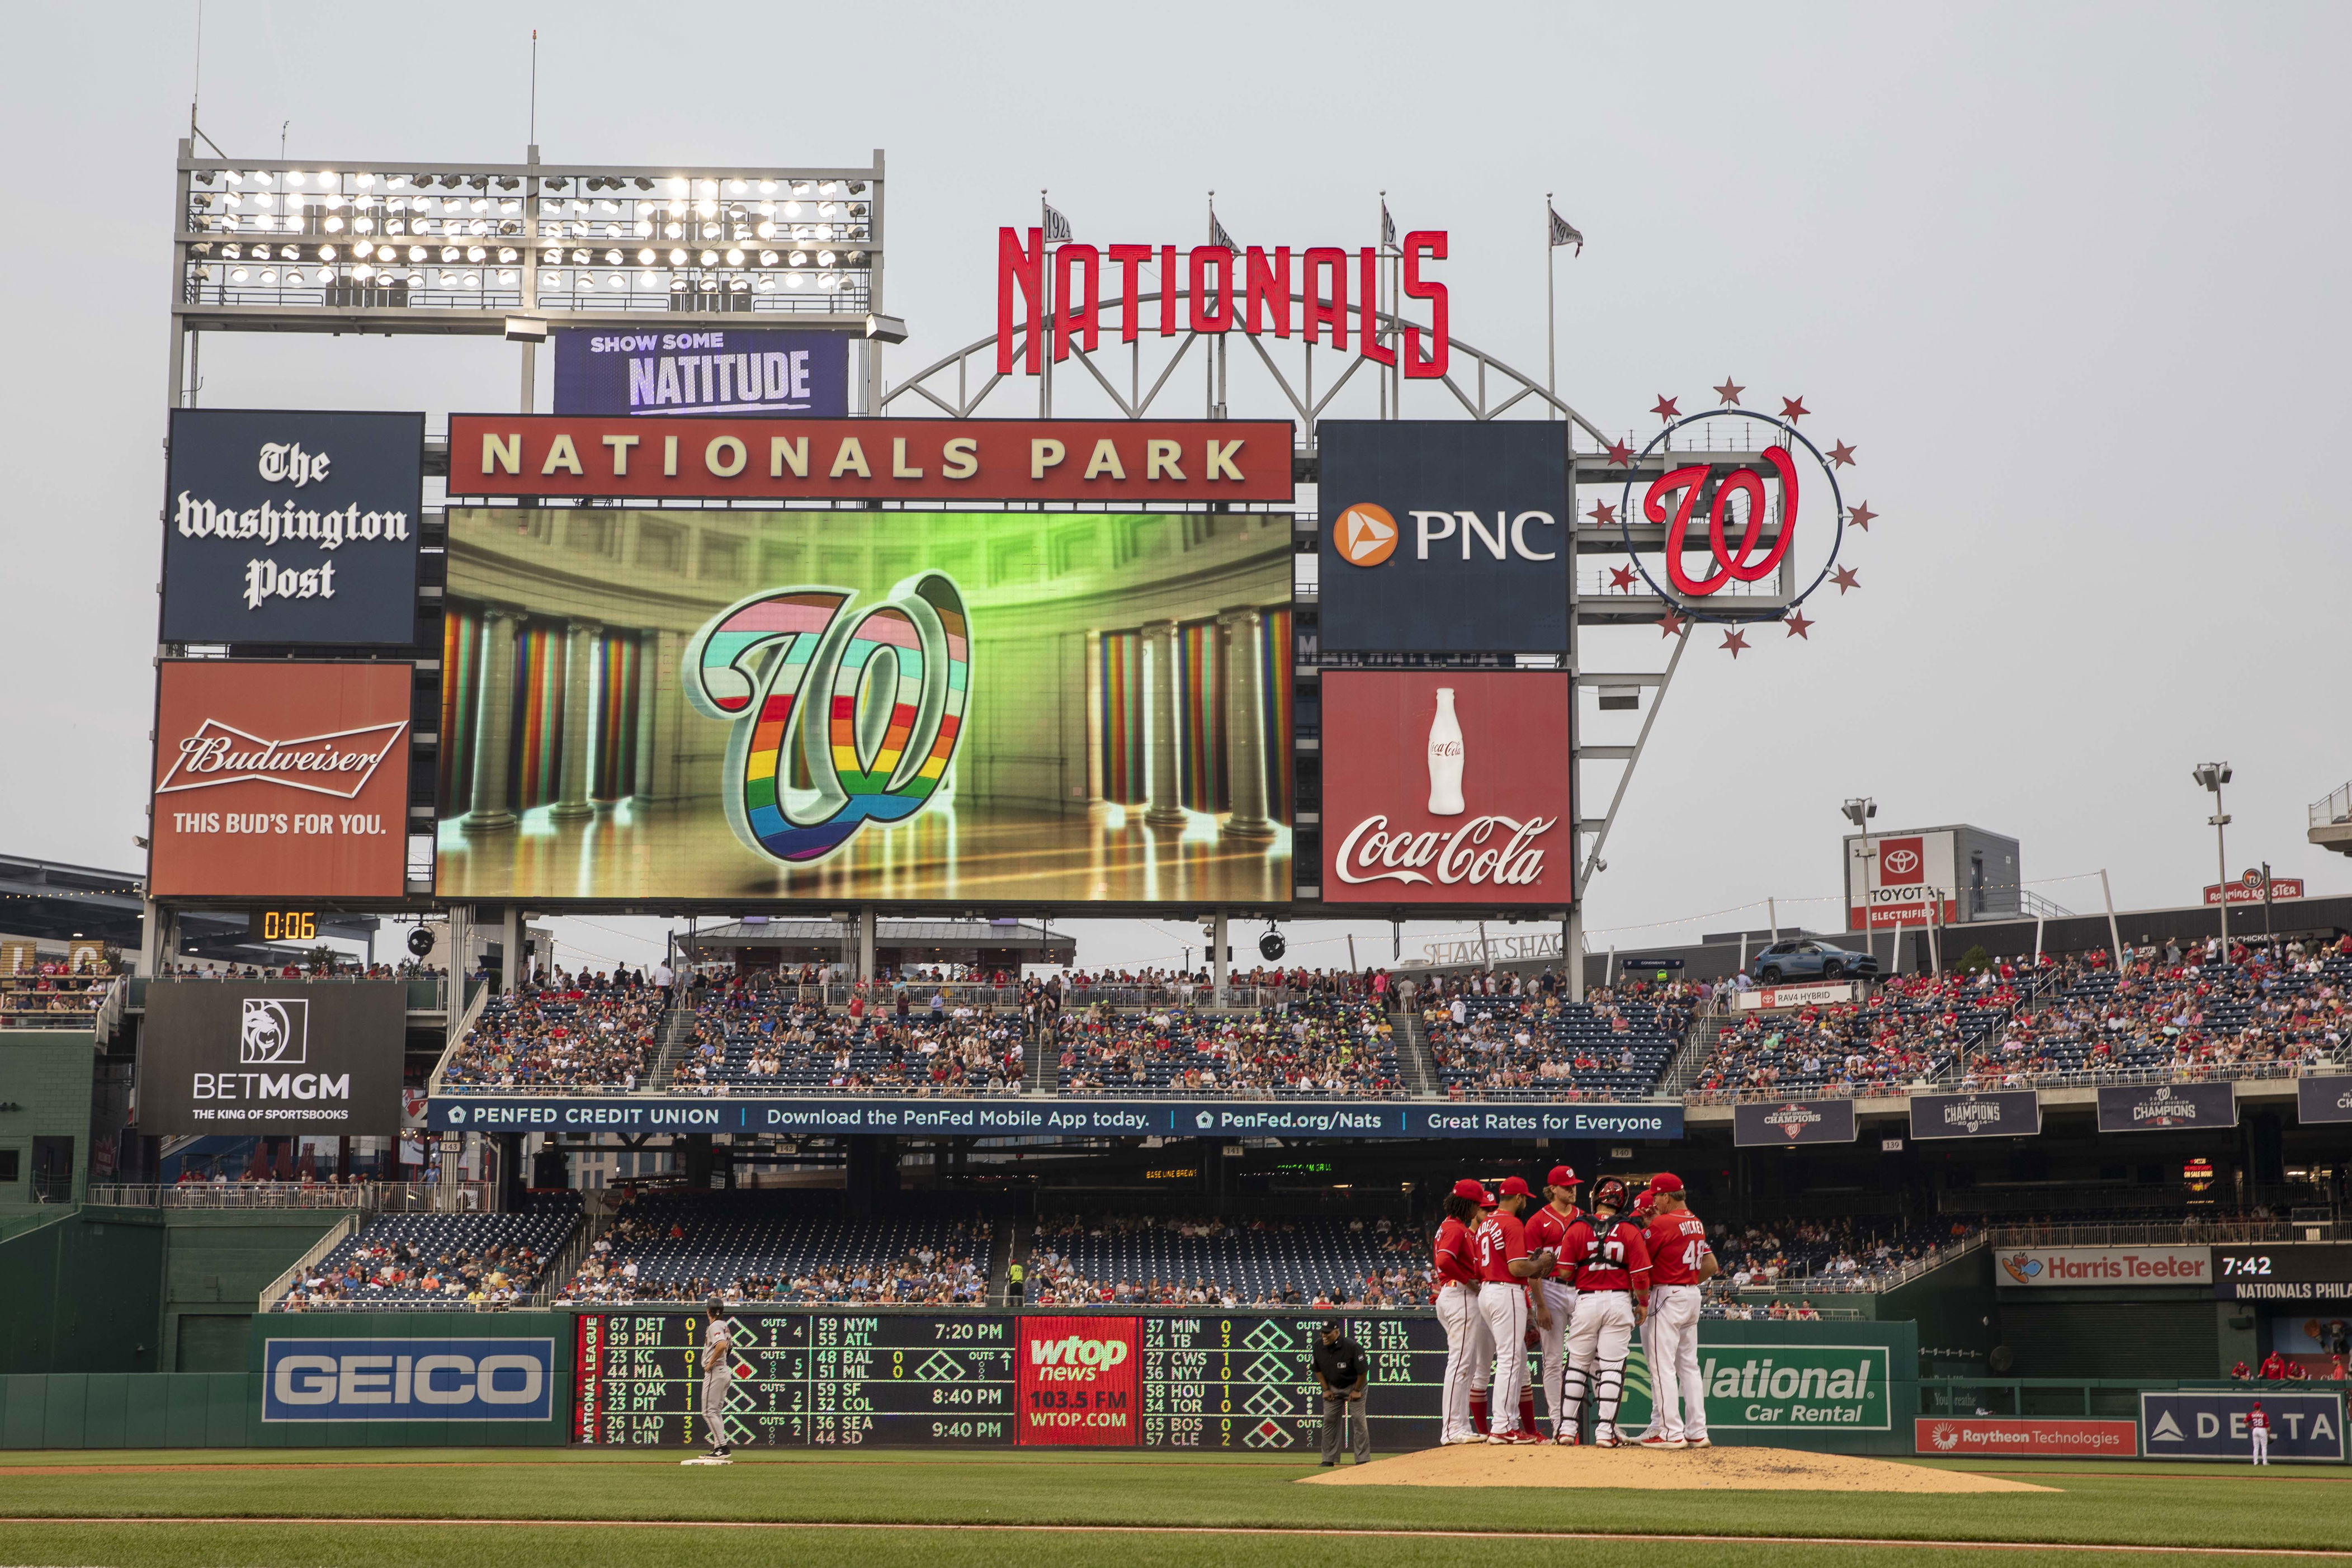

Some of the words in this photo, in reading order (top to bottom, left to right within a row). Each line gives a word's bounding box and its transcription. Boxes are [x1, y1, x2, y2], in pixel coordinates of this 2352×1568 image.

[997, 226, 1449, 380] NATIONALS
[591, 334, 658, 353] SHOW
[663, 332, 724, 350] SOME
[629, 351, 810, 406] NATITUDE
[481, 432, 979, 481] NATIONALS
[1031, 438, 1246, 481] PARK
[258, 442, 331, 488] The
[174, 490, 410, 550] Washington
[1409, 511, 1556, 561] PNC
[243, 558, 336, 610] Post
[179, 736, 381, 773] Budweiser
[173, 813, 220, 833] THIS
[225, 814, 288, 834] BUD'S
[294, 815, 333, 834] FOR
[339, 815, 386, 834] YOU.
[1335, 815, 1557, 886] Coca-Cola
[265, 912, 314, 939] 0:06
[1778, 994, 1797, 1002] RAV4
[1801, 991, 1830, 1000] HYBRID
[193, 1073, 350, 1099] BETMGM
[192, 1109, 215, 1119] THE
[218, 1109, 245, 1119] KING
[248, 1109, 263, 1119] OF
[265, 1109, 348, 1119] SPORTSBOOKS
[474, 1108, 557, 1123] PENFED
[565, 1108, 643, 1123] CREDIT
[650, 1109, 719, 1124] UNION
[767, 1109, 861, 1125] Download
[867, 1110, 897, 1125] the
[904, 1111, 973, 1126] PenFed
[980, 1111, 1041, 1126] Mobile
[1048, 1112, 1087, 1128] App
[1093, 1111, 1150, 1129] today.
[1764, 1114, 1821, 1124] CHAMPIONS
[1944, 1105, 2000, 1123] CHAMPIONS
[2133, 1104, 2195, 1120] CHAMPIONS
[1221, 1112, 1381, 1131] PenFed.org/Nats
[1427, 1113, 1482, 1130] Great
[1485, 1114, 1539, 1130] Rates
[1542, 1114, 1569, 1130] for
[1575, 1115, 1663, 1132] Everyone
[780, 1144, 794, 1153] 142
[1886, 1141, 1899, 1150] 139
[1678, 1220, 1704, 1236] HICKEY
[1481, 1236, 1490, 1267] 9
[1682, 1240, 1704, 1271] 48
[2048, 1257, 2122, 1279] Harris
[2123, 1255, 2205, 1277] Teeter
[2222, 1257, 2271, 1276] 7:42
[2236, 1283, 2312, 1299] NATIONALS
[610, 1318, 628, 1331] 67
[635, 1317, 665, 1331] DET
[761, 1319, 787, 1328] OUTS
[819, 1318, 838, 1331] 59
[844, 1318, 877, 1331] NYM
[1146, 1320, 1164, 1334] 37
[1171, 1320, 1200, 1334] MIN
[1354, 1321, 1372, 1334] 52
[1379, 1321, 1407, 1335] STL
[609, 1333, 628, 1345] 99
[635, 1333, 661, 1345] PHI
[935, 1324, 973, 1339] 7:20
[978, 1324, 1002, 1339] PM
[585, 1317, 597, 1371] LEAGUE
[819, 1333, 837, 1346] 55
[844, 1333, 872, 1346] ATL
[1146, 1335, 1164, 1348] 24
[1171, 1335, 1191, 1348] TB
[1378, 1336, 1409, 1349] TEX
[610, 1350, 627, 1363] 23
[634, 1350, 655, 1363] KC
[760, 1351, 786, 1359] OUTS
[817, 1350, 837, 1364] 48
[843, 1350, 873, 1364] BAL
[1031, 1336, 1127, 1371] wtop
[1146, 1352, 1164, 1366] 27
[1171, 1352, 1207, 1366] CWS
[1379, 1354, 1411, 1367] CHC
[608, 1365, 628, 1378] 44
[634, 1365, 664, 1378] MIA
[820, 1365, 834, 1378] 51
[843, 1365, 870, 1378] MIL
[1039, 1366, 1096, 1381] news
[1146, 1367, 1164, 1380] 36
[1171, 1367, 1203, 1380] NYY
[1379, 1368, 1411, 1382] LAA
[275, 1355, 542, 1404] GEICO
[608, 1383, 626, 1396] 32
[634, 1383, 666, 1396] OAK
[759, 1383, 785, 1392] OUTS
[818, 1383, 836, 1396] 59
[843, 1383, 861, 1396] SF
[1146, 1385, 1164, 1398] 58
[1171, 1385, 1205, 1398] HOU
[933, 1388, 972, 1404] 8:40
[977, 1389, 1002, 1404] PM
[1031, 1391, 1087, 1409] 103.5
[1095, 1391, 1126, 1409] FM
[583, 1378, 596, 1443] NATIONAL
[608, 1397, 626, 1410] 23
[633, 1397, 657, 1411] PIT
[818, 1398, 835, 1411] 32
[843, 1397, 873, 1411] COL
[1146, 1399, 1164, 1413] 34
[1171, 1399, 1203, 1413] TOR
[759, 1416, 785, 1425] OUTS
[1031, 1412, 1126, 1427] WTOP.COM
[1745, 1405, 1783, 1422] Car
[1791, 1405, 1862, 1422] Rental
[607, 1416, 625, 1429] 26
[633, 1416, 664, 1429] LAD
[816, 1416, 835, 1430] 36
[842, 1416, 873, 1430] SEA
[932, 1421, 972, 1437] 9:40
[977, 1422, 1001, 1437] PM
[1146, 1418, 1164, 1431] 65
[1171, 1418, 1203, 1431] BOS
[2198, 1412, 2336, 1441] DETA
[606, 1431, 625, 1444] 34
[632, 1431, 659, 1444] CIN
[815, 1431, 835, 1444] 44
[842, 1431, 862, 1444] SD
[1146, 1432, 1164, 1446] 57
[1171, 1432, 1199, 1446] CLE
[1963, 1429, 2029, 1445] Raytheon
[2032, 1430, 2119, 1447] Technologies
